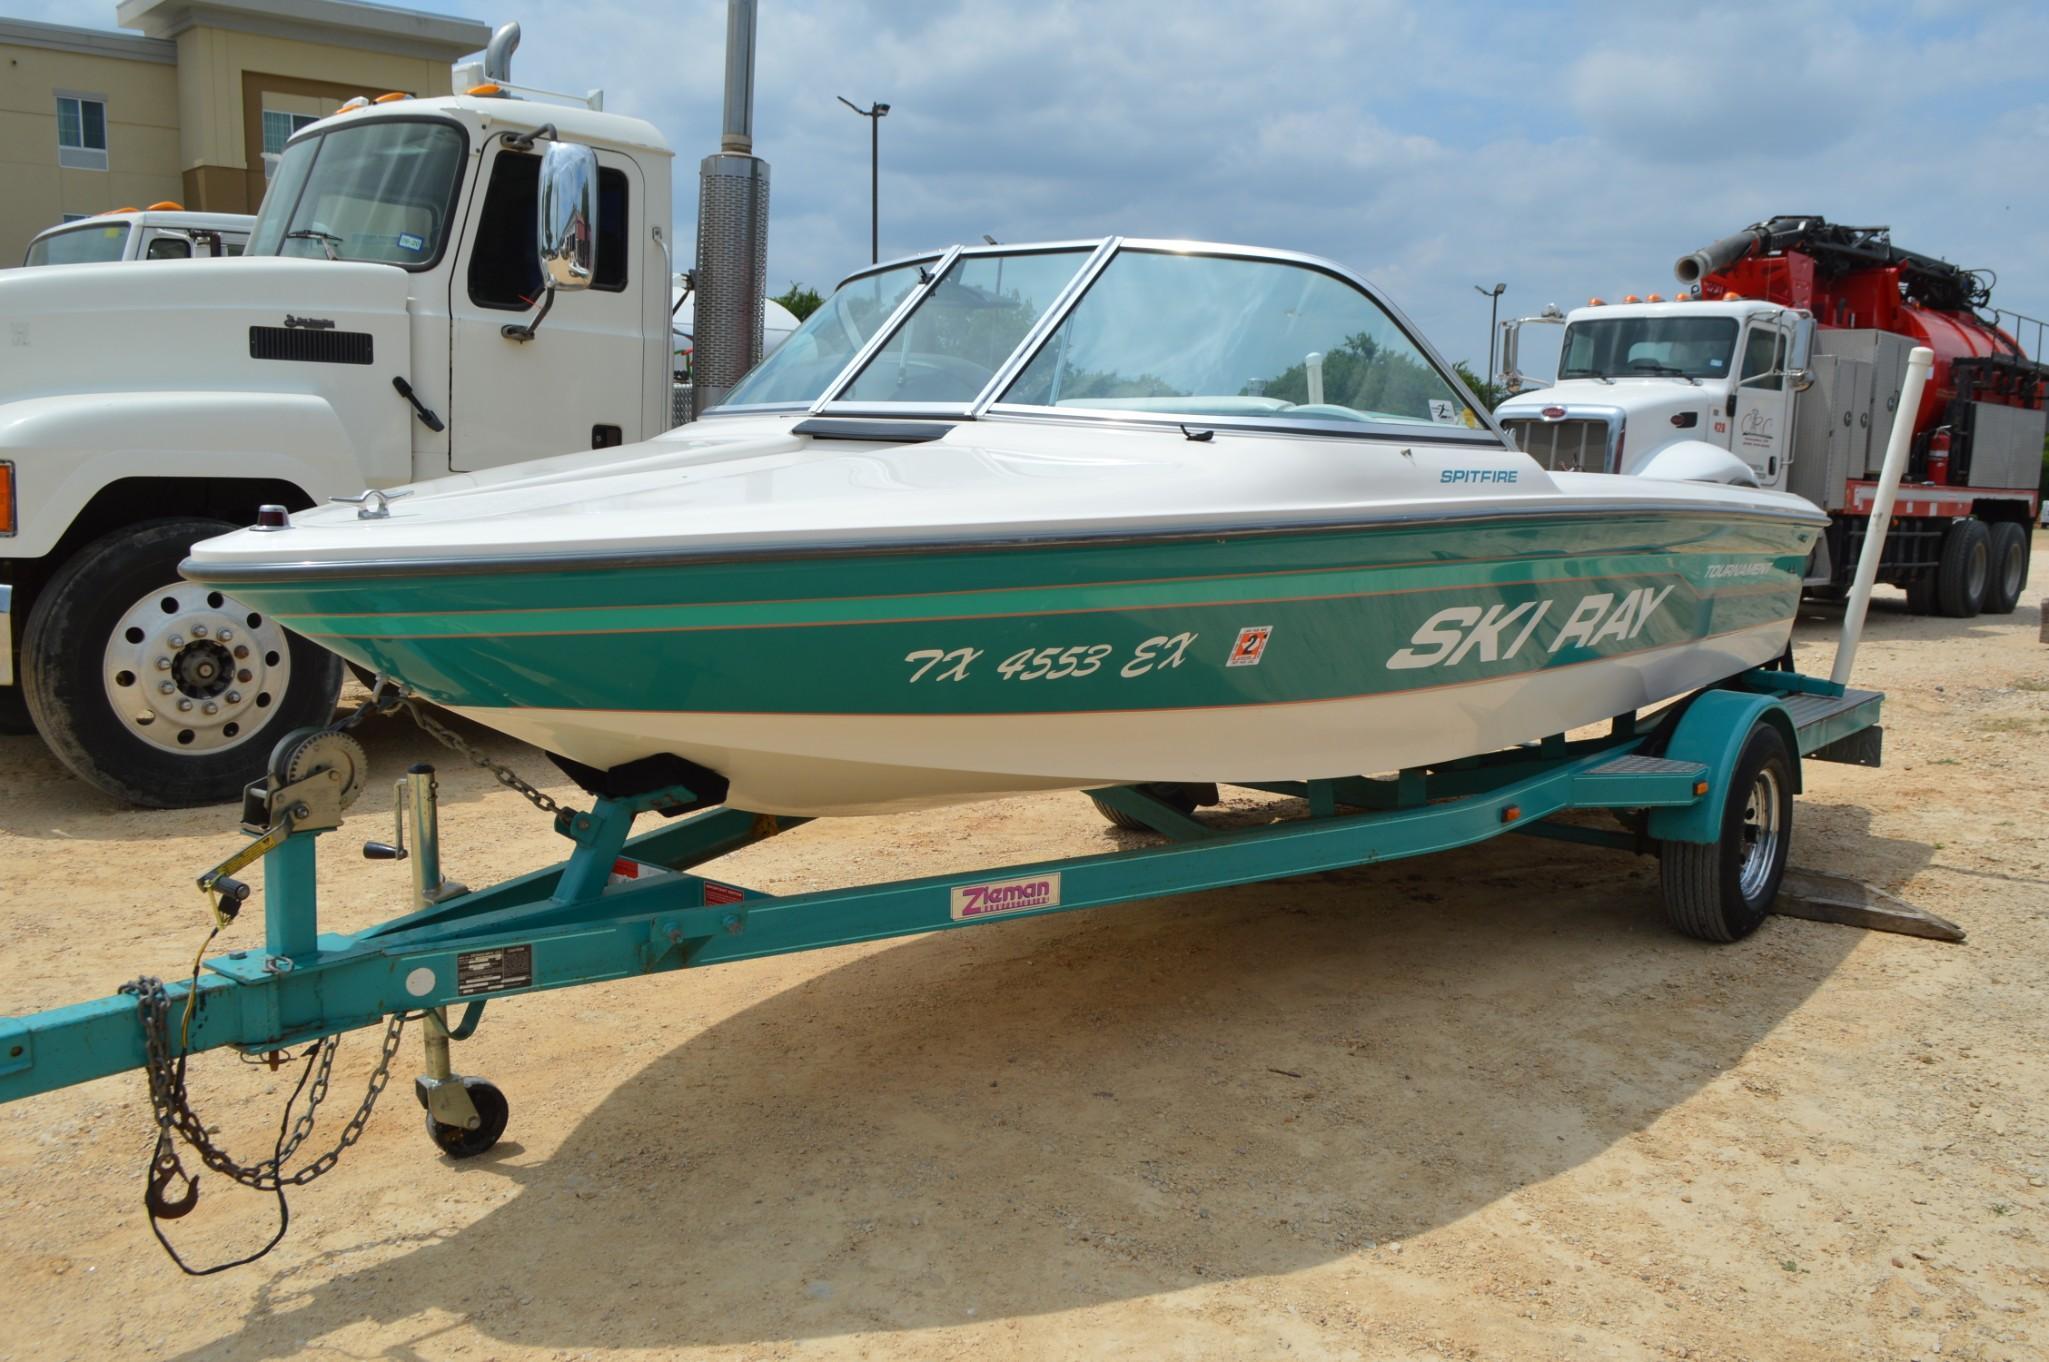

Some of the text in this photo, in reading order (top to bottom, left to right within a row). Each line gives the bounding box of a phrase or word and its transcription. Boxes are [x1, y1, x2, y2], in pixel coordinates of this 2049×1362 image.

[1440, 470, 1518, 484] SPITFIRE
[1703, 562, 1774, 579] TOURNAMENT
[1386, 585, 1676, 670] SKI RAY
[904, 632, 1199, 684] TX 4553 EX
[1242, 633, 1259, 656] 2
[962, 881, 1050, 916] Zieman
